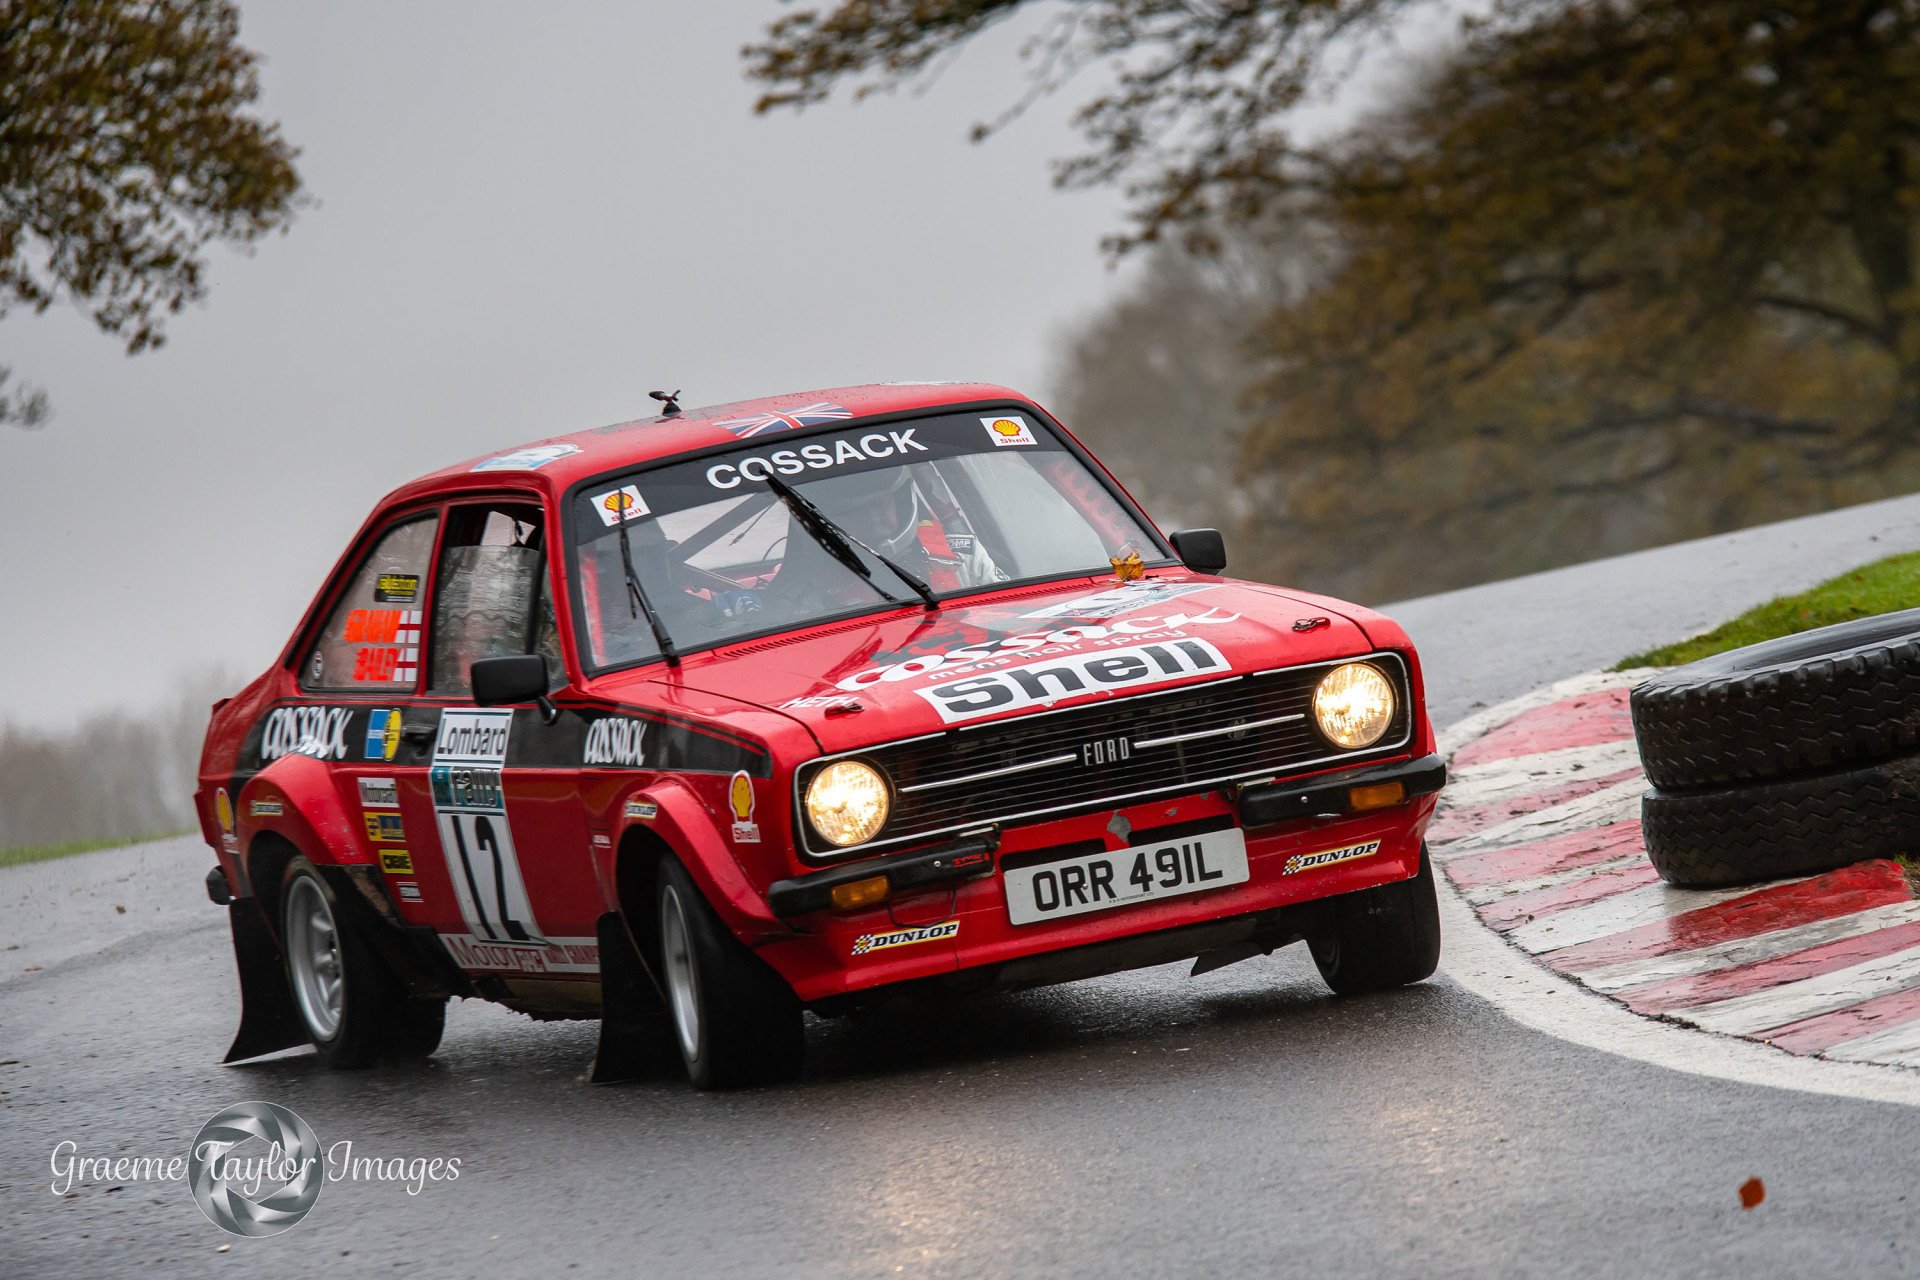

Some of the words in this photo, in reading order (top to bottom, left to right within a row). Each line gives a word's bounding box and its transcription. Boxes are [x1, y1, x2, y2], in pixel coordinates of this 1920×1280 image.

[706, 429, 929, 489] COSSACK
[611, 508, 642, 521] Sell
[928, 656, 1011, 680] mens
[1016, 643, 1082, 659] hair
[1094, 629, 1188, 646] spray
[931, 640, 1217, 713] Shell
[1083, 737, 1130, 766] FORD
[452, 815, 531, 941] 12
[1032, 859, 1115, 912] ORR
[1129, 842, 1223, 893] 491L
[1301, 842, 1378, 867] DUNLOP
[872, 923, 957, 947] DUNLOP
